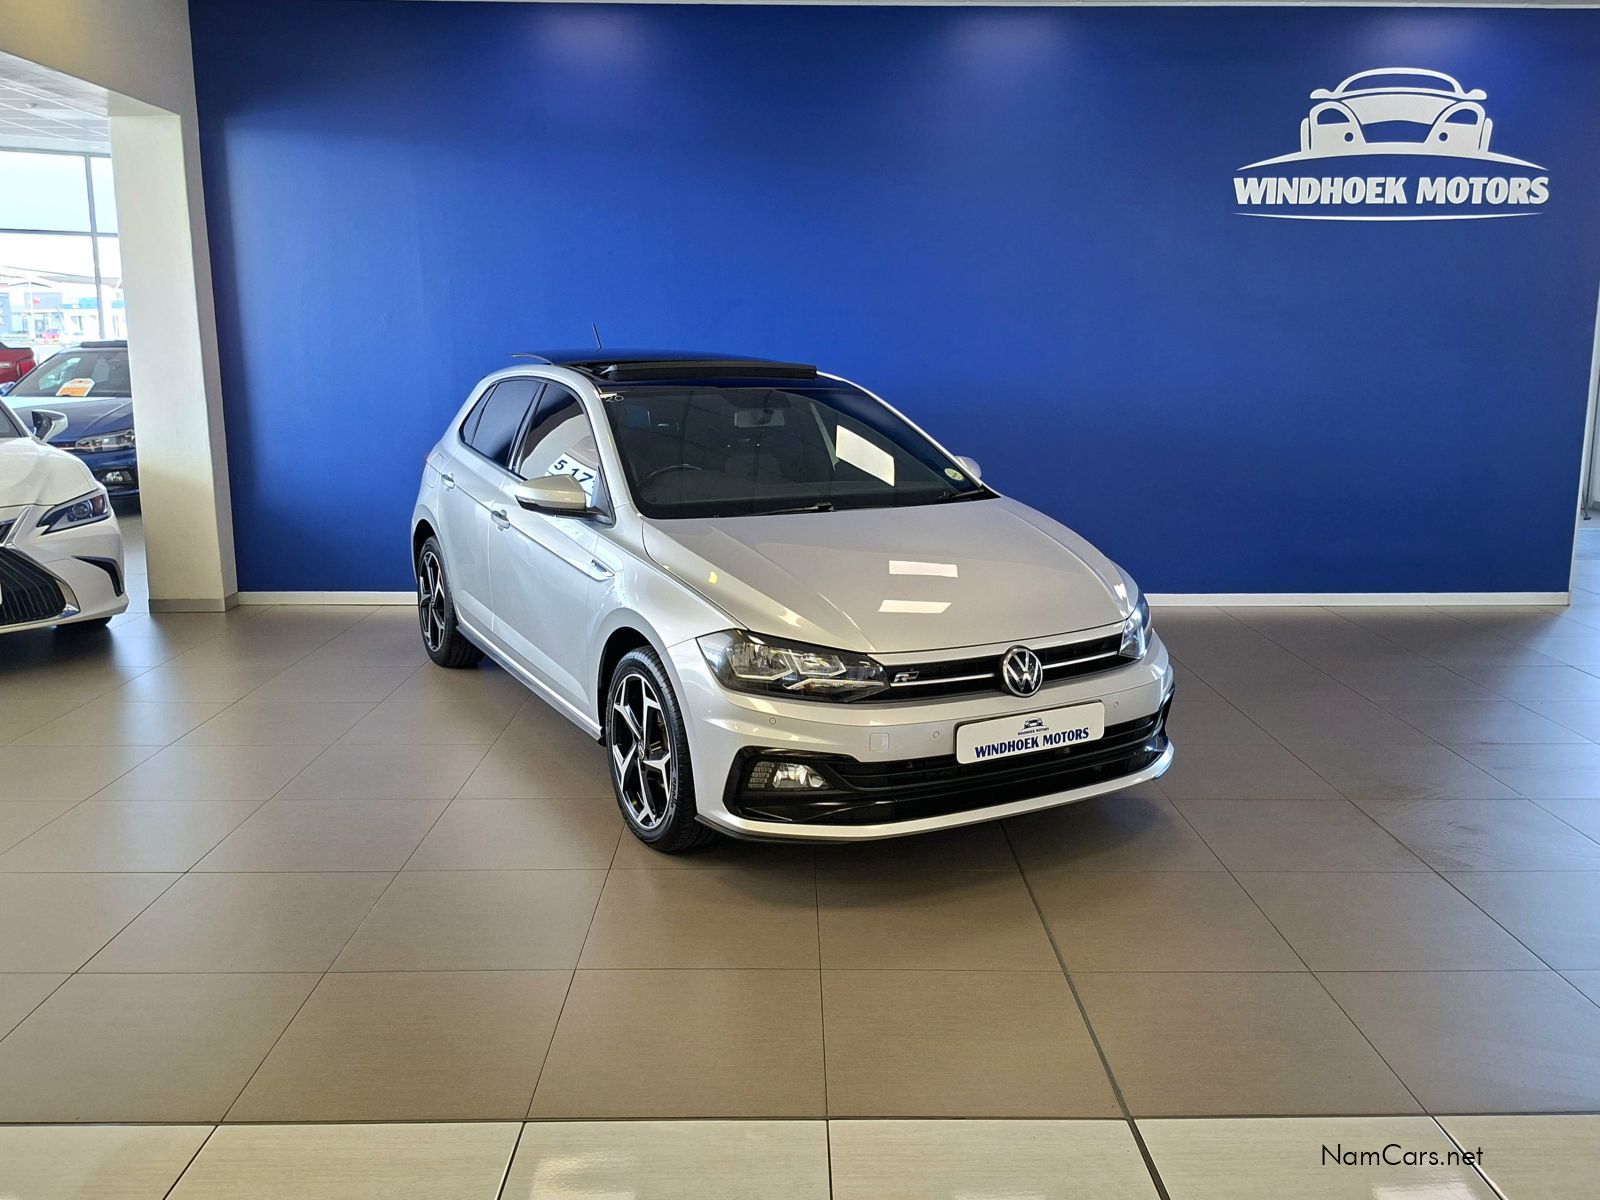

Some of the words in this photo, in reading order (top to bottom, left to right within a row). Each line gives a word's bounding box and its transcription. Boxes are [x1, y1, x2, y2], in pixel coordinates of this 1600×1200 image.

[1233, 177, 1407, 205] WINDHOEK
[1415, 176, 1550, 205] MOTORS
[974, 737, 1040, 758] WINDHOEK
[1042, 727, 1089, 746] MOTORS
